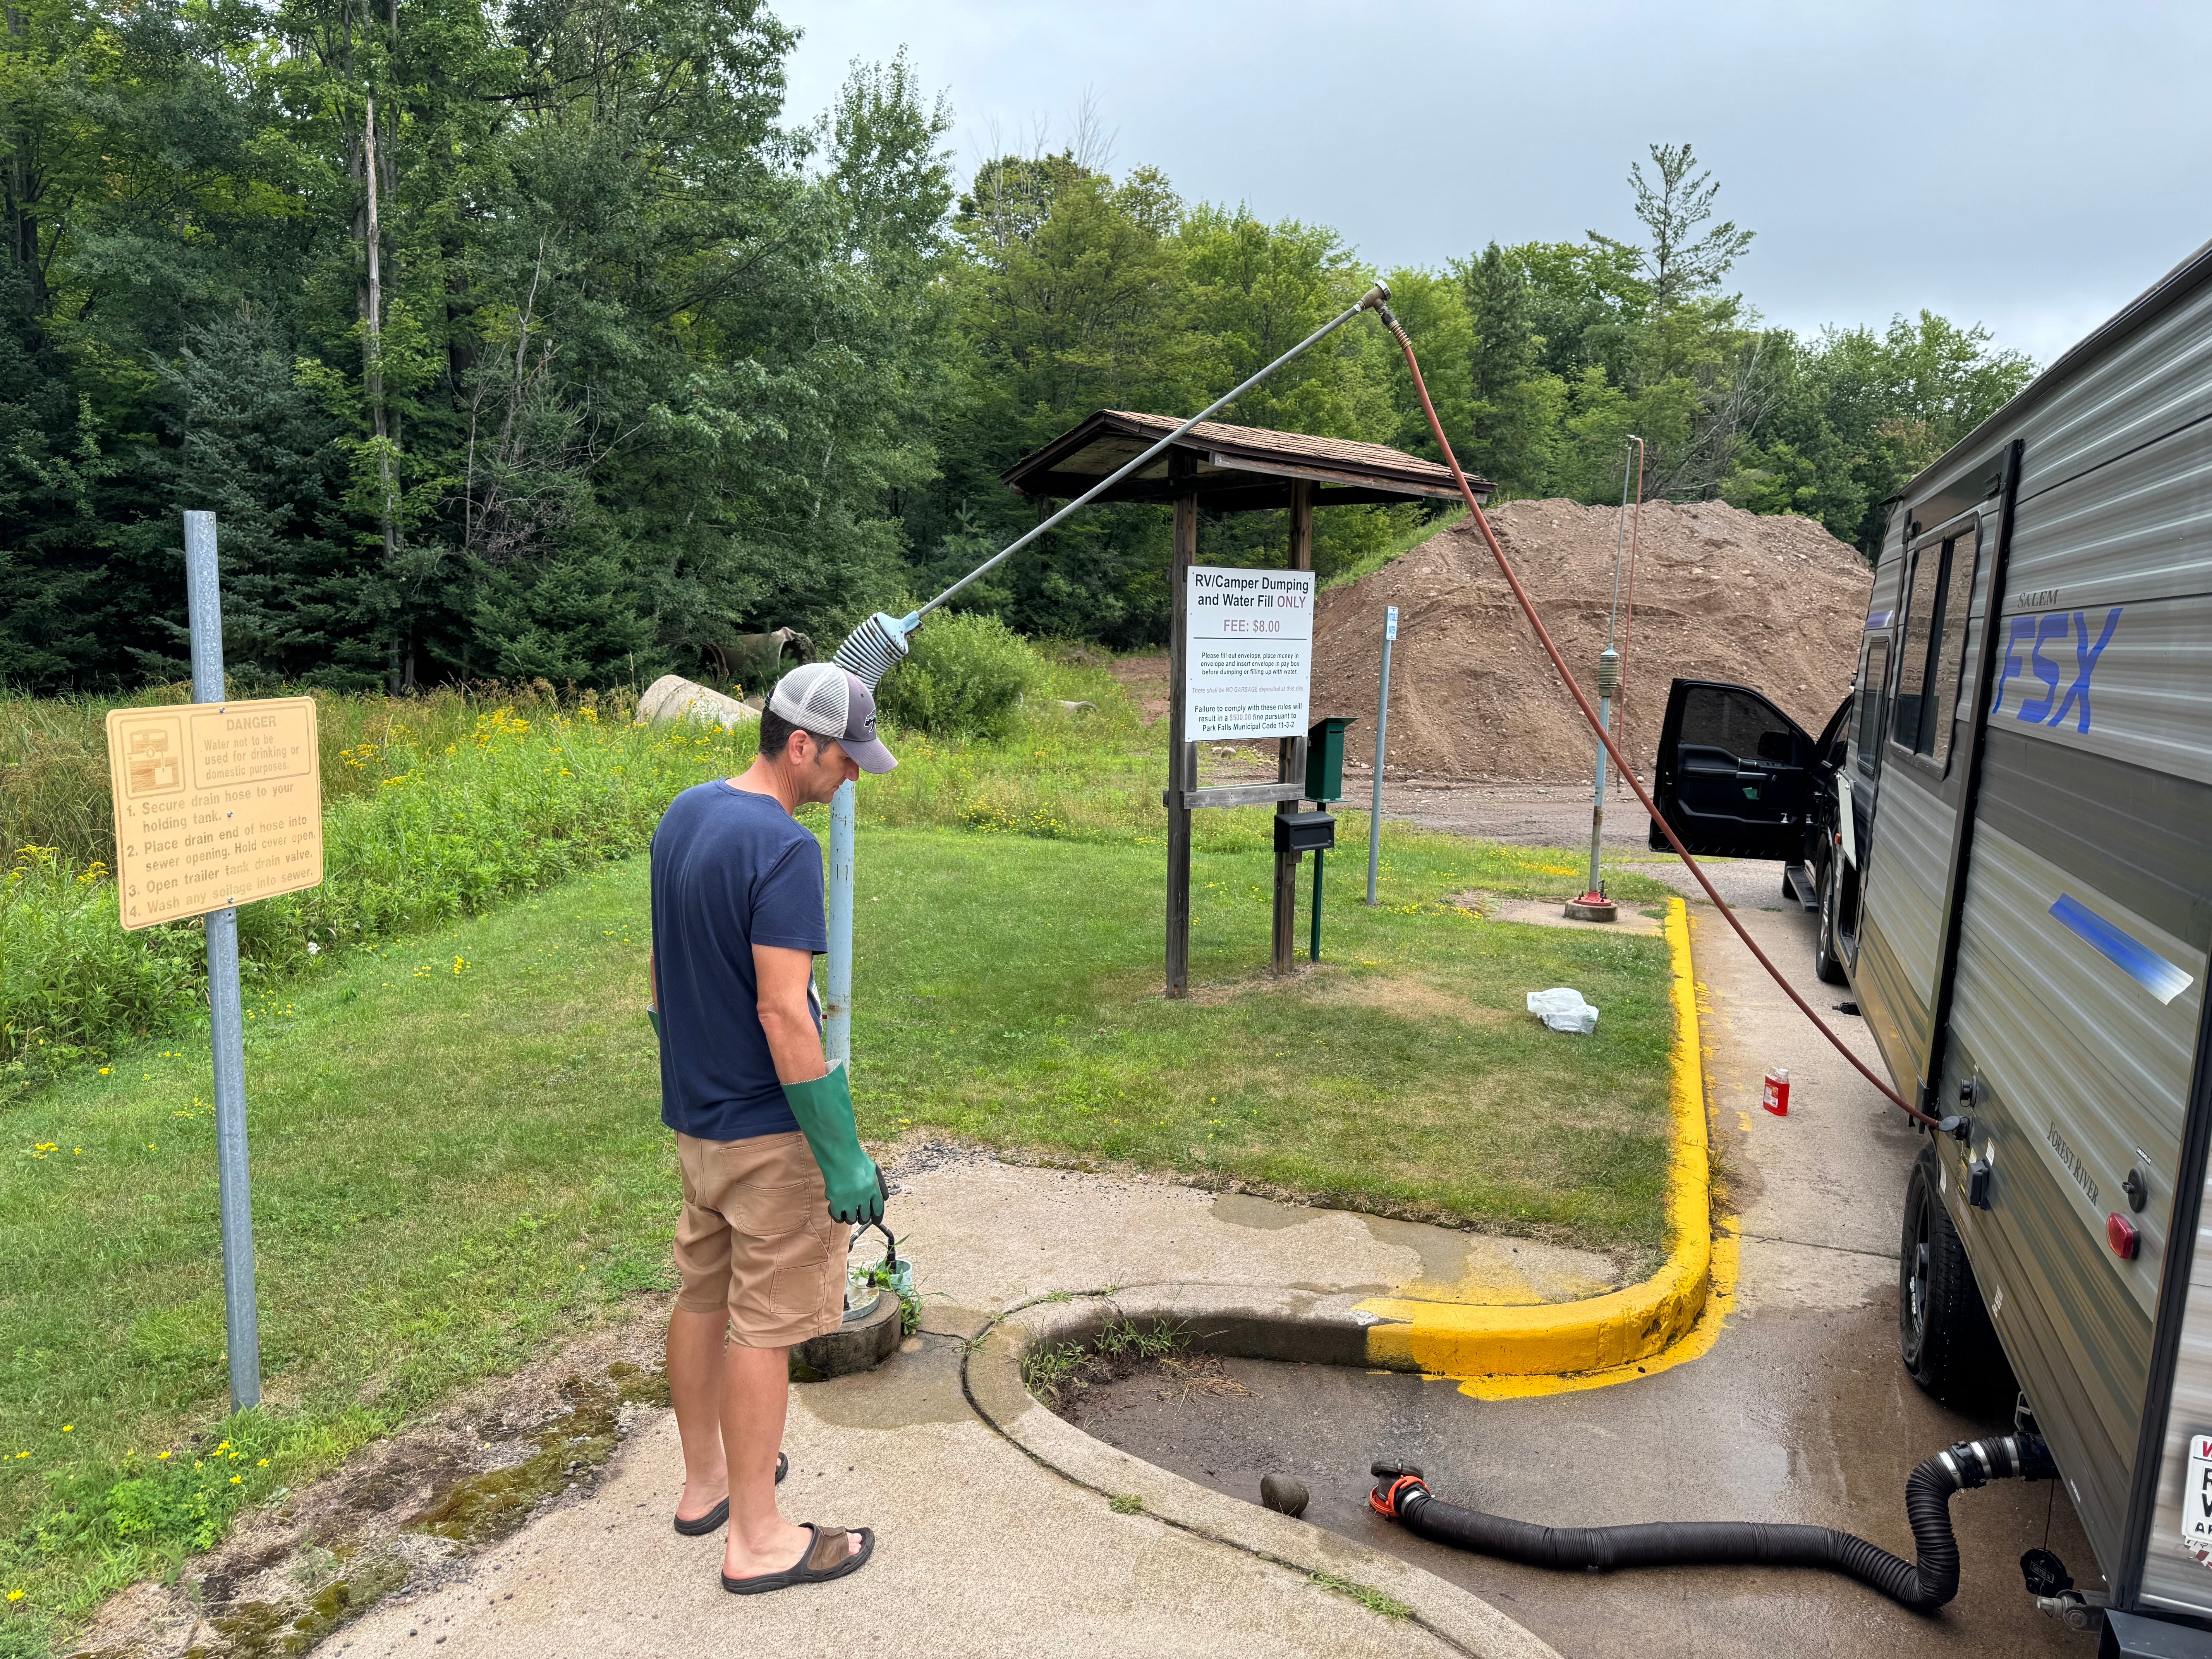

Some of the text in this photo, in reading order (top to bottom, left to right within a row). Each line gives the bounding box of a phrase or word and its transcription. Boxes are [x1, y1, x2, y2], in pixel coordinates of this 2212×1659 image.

[1195, 574, 1309, 594] RV/Camper Dumping
[1198, 594, 1306, 608] and Water Fill ONLY
[2017, 589, 2059, 608] SALEM
[1224, 619, 1280, 632] FEE: $8.00
[1992, 608, 2123, 735] FSX
[1225, 705, 1246, 713] comply
[227, 716, 276, 731] DANGER
[1233, 722, 1261, 731] Municipal
[204, 734, 273, 751] Water not to be
[205, 745, 299, 765] used for drinking or
[206, 762, 289, 780] domestic purposes.
[127, 783, 294, 817] 1. Secure drain hose to your
[143, 812, 221, 833] holding tank.
[127, 816, 307, 857] 2. Place drain end of hose into
[146, 832, 316, 872] sewer opening. Hold cover open.
[129, 850, 312, 897] 3. Open trailer tank drain valve.
[129, 869, 313, 917] 4. Wash any soilage into sewer.
[2047, 1120, 2099, 1206] FOREST RIVER
